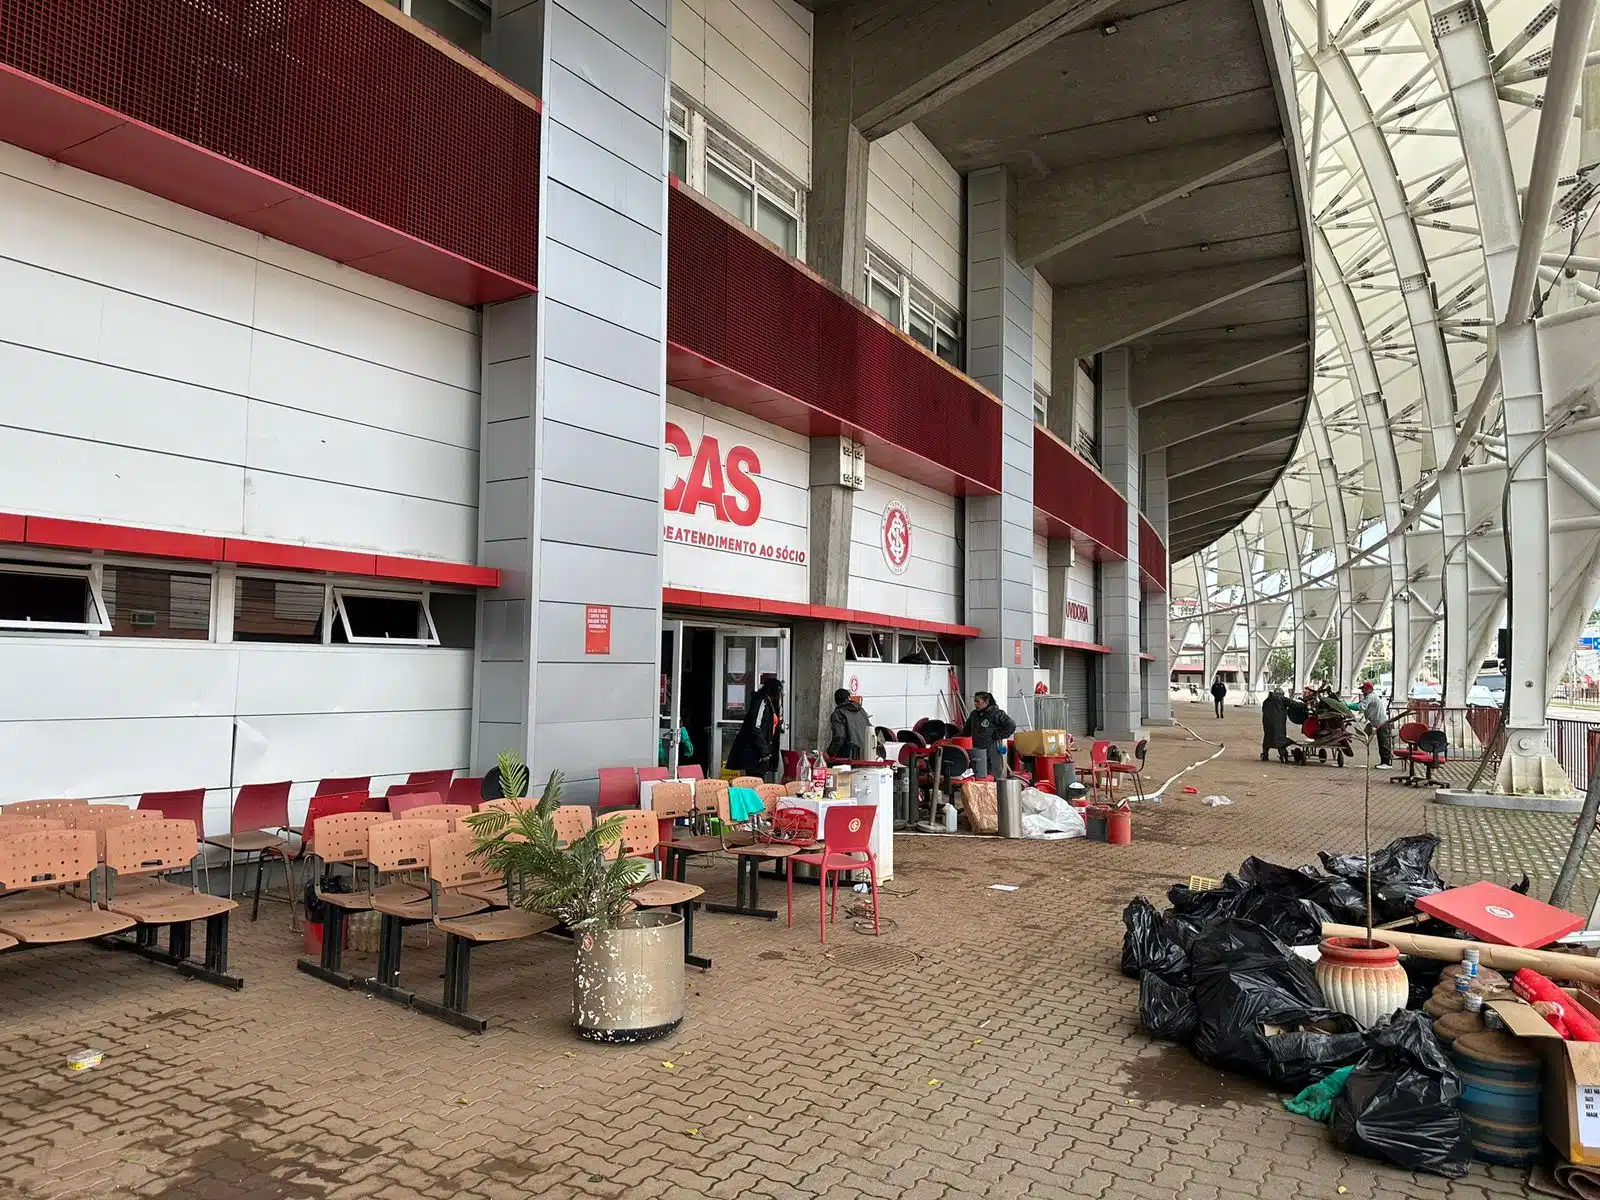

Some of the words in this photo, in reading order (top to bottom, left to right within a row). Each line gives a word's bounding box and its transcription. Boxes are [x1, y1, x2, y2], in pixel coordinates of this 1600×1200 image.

[664, 421, 762, 527] CAS
[675, 527, 757, 554] ATENDIMENTO
[759, 544, 774, 558] AO
[775, 545, 806, 563] SÓCIO
